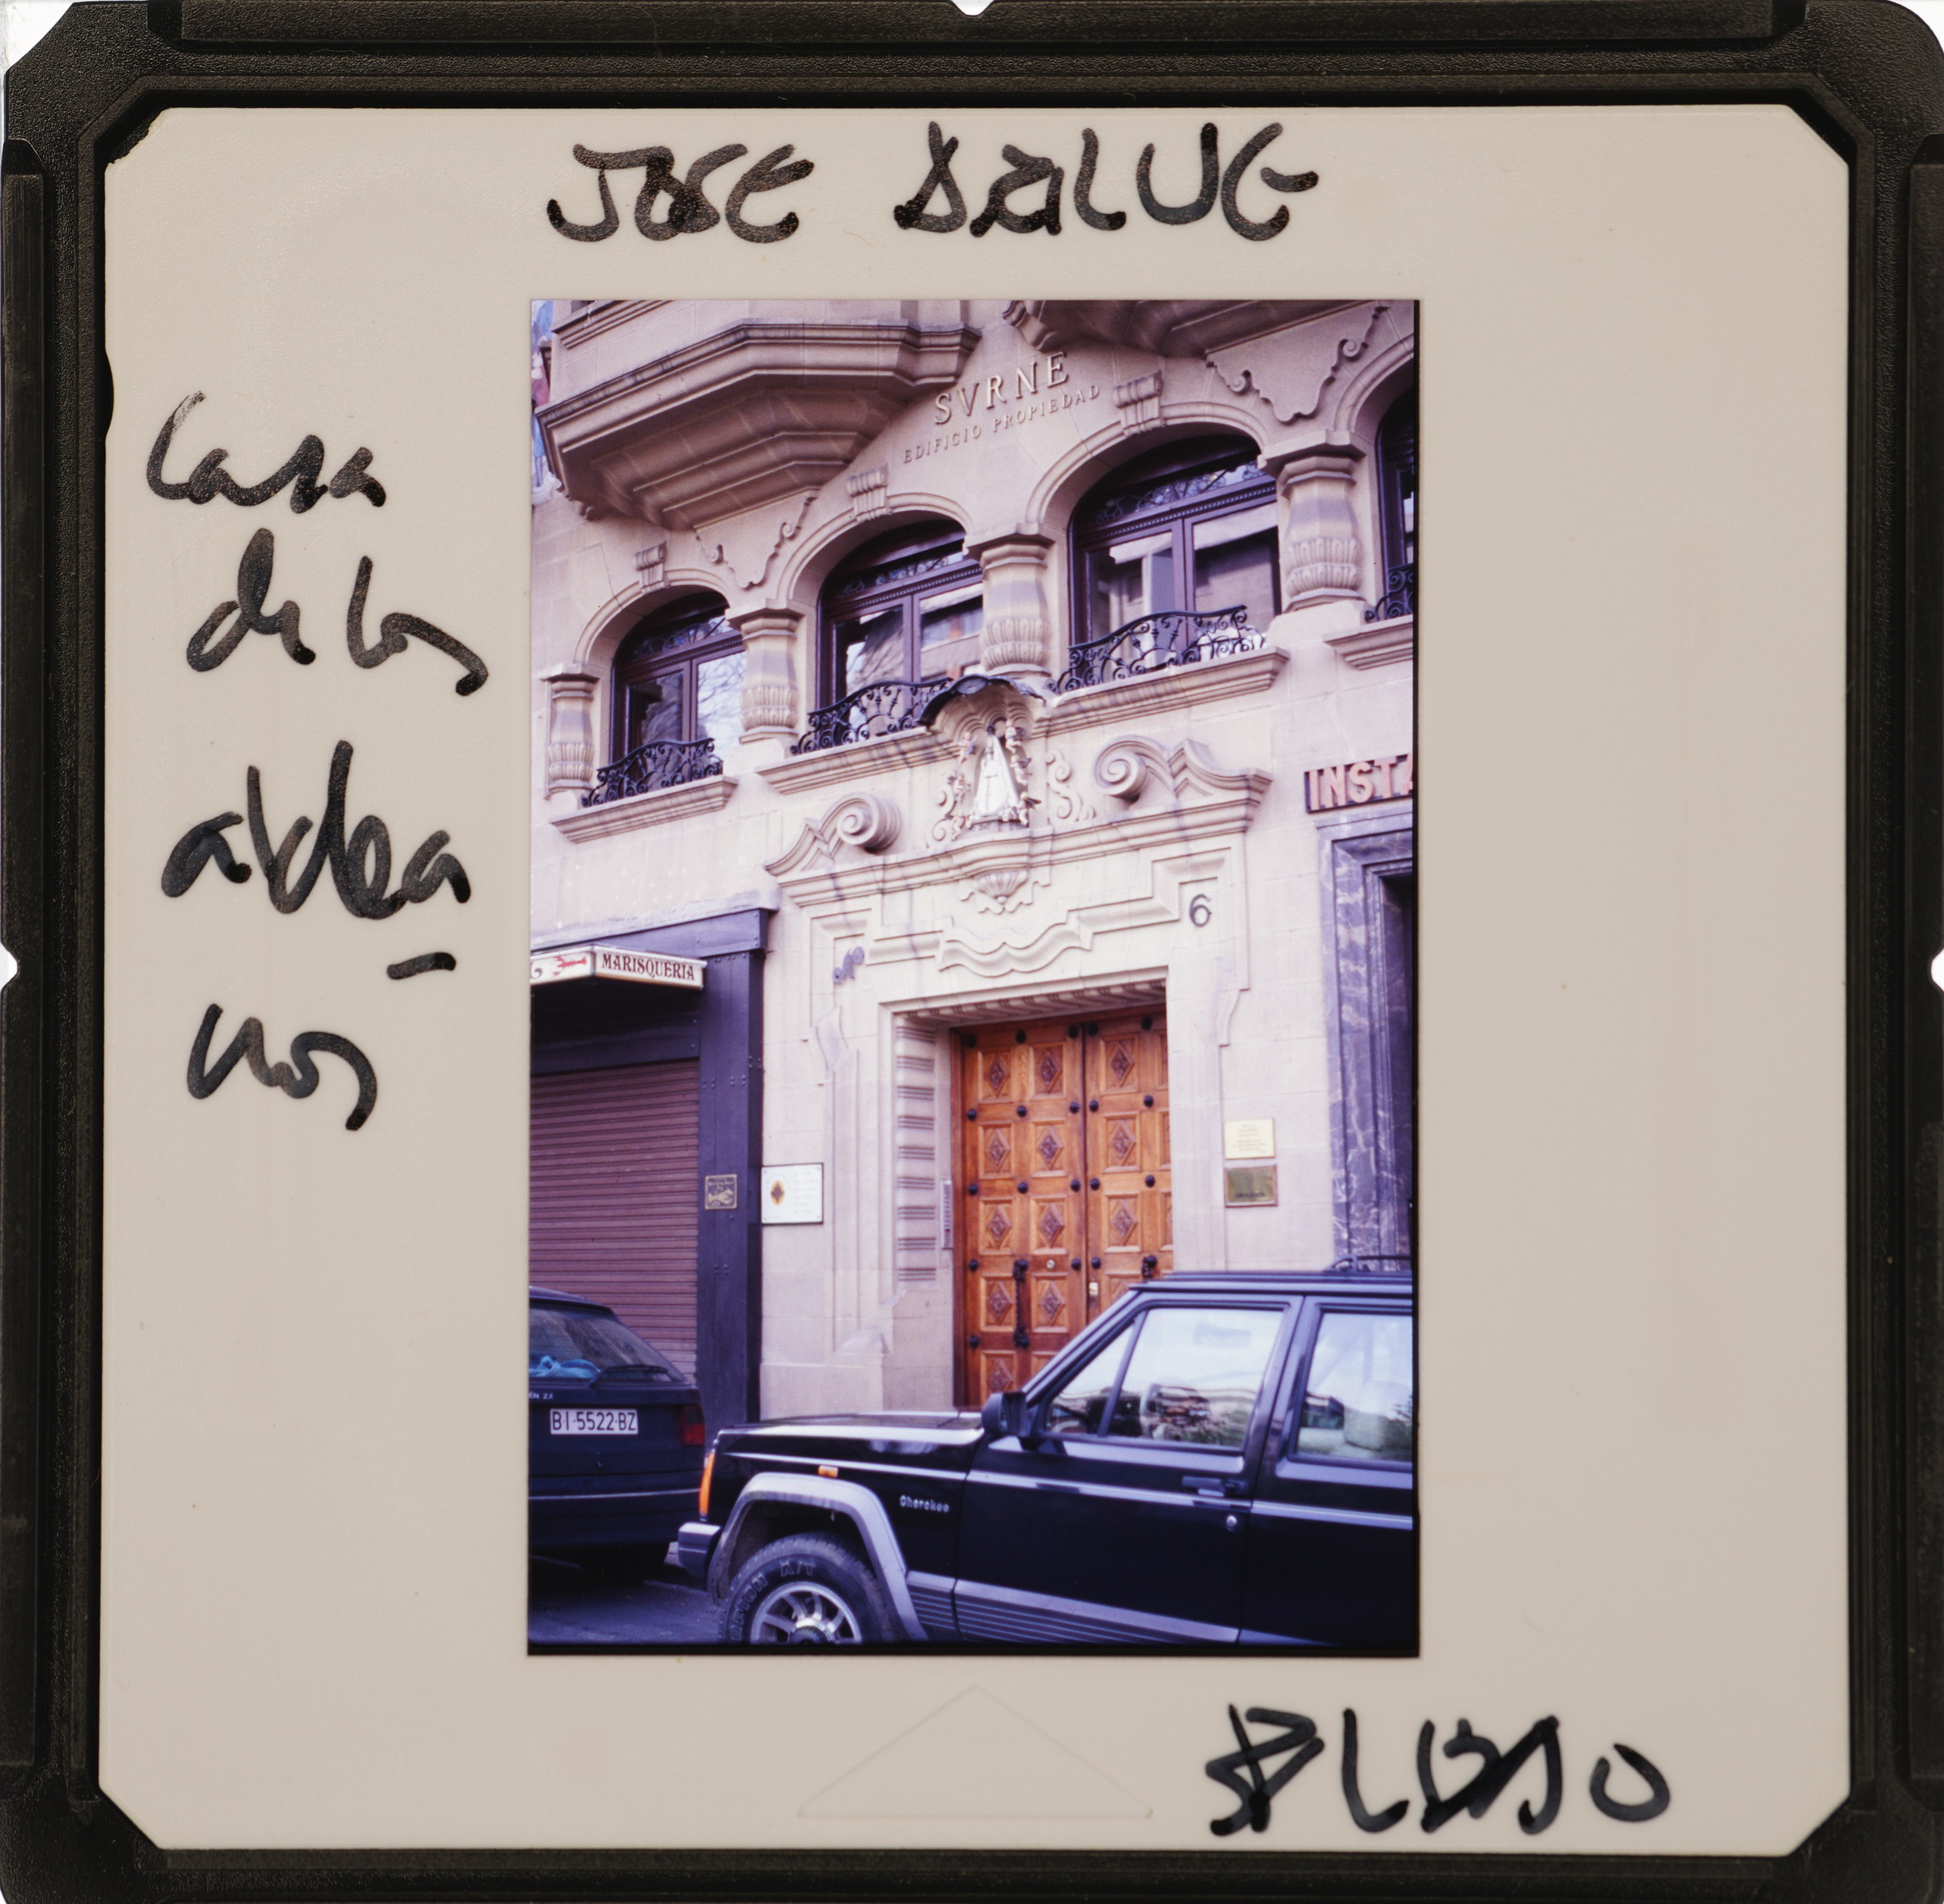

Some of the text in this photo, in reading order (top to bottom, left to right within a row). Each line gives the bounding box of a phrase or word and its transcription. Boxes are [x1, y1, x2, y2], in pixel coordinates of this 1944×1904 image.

[934, 351, 1070, 425] SVRNE
[903, 384, 1100, 464] EDIFICIO PROPIEDAD
[1189, 893, 1212, 928] 6
[601, 953, 696, 981] MARISQUERIA
[900, 1495, 950, 1513] Cherokee
